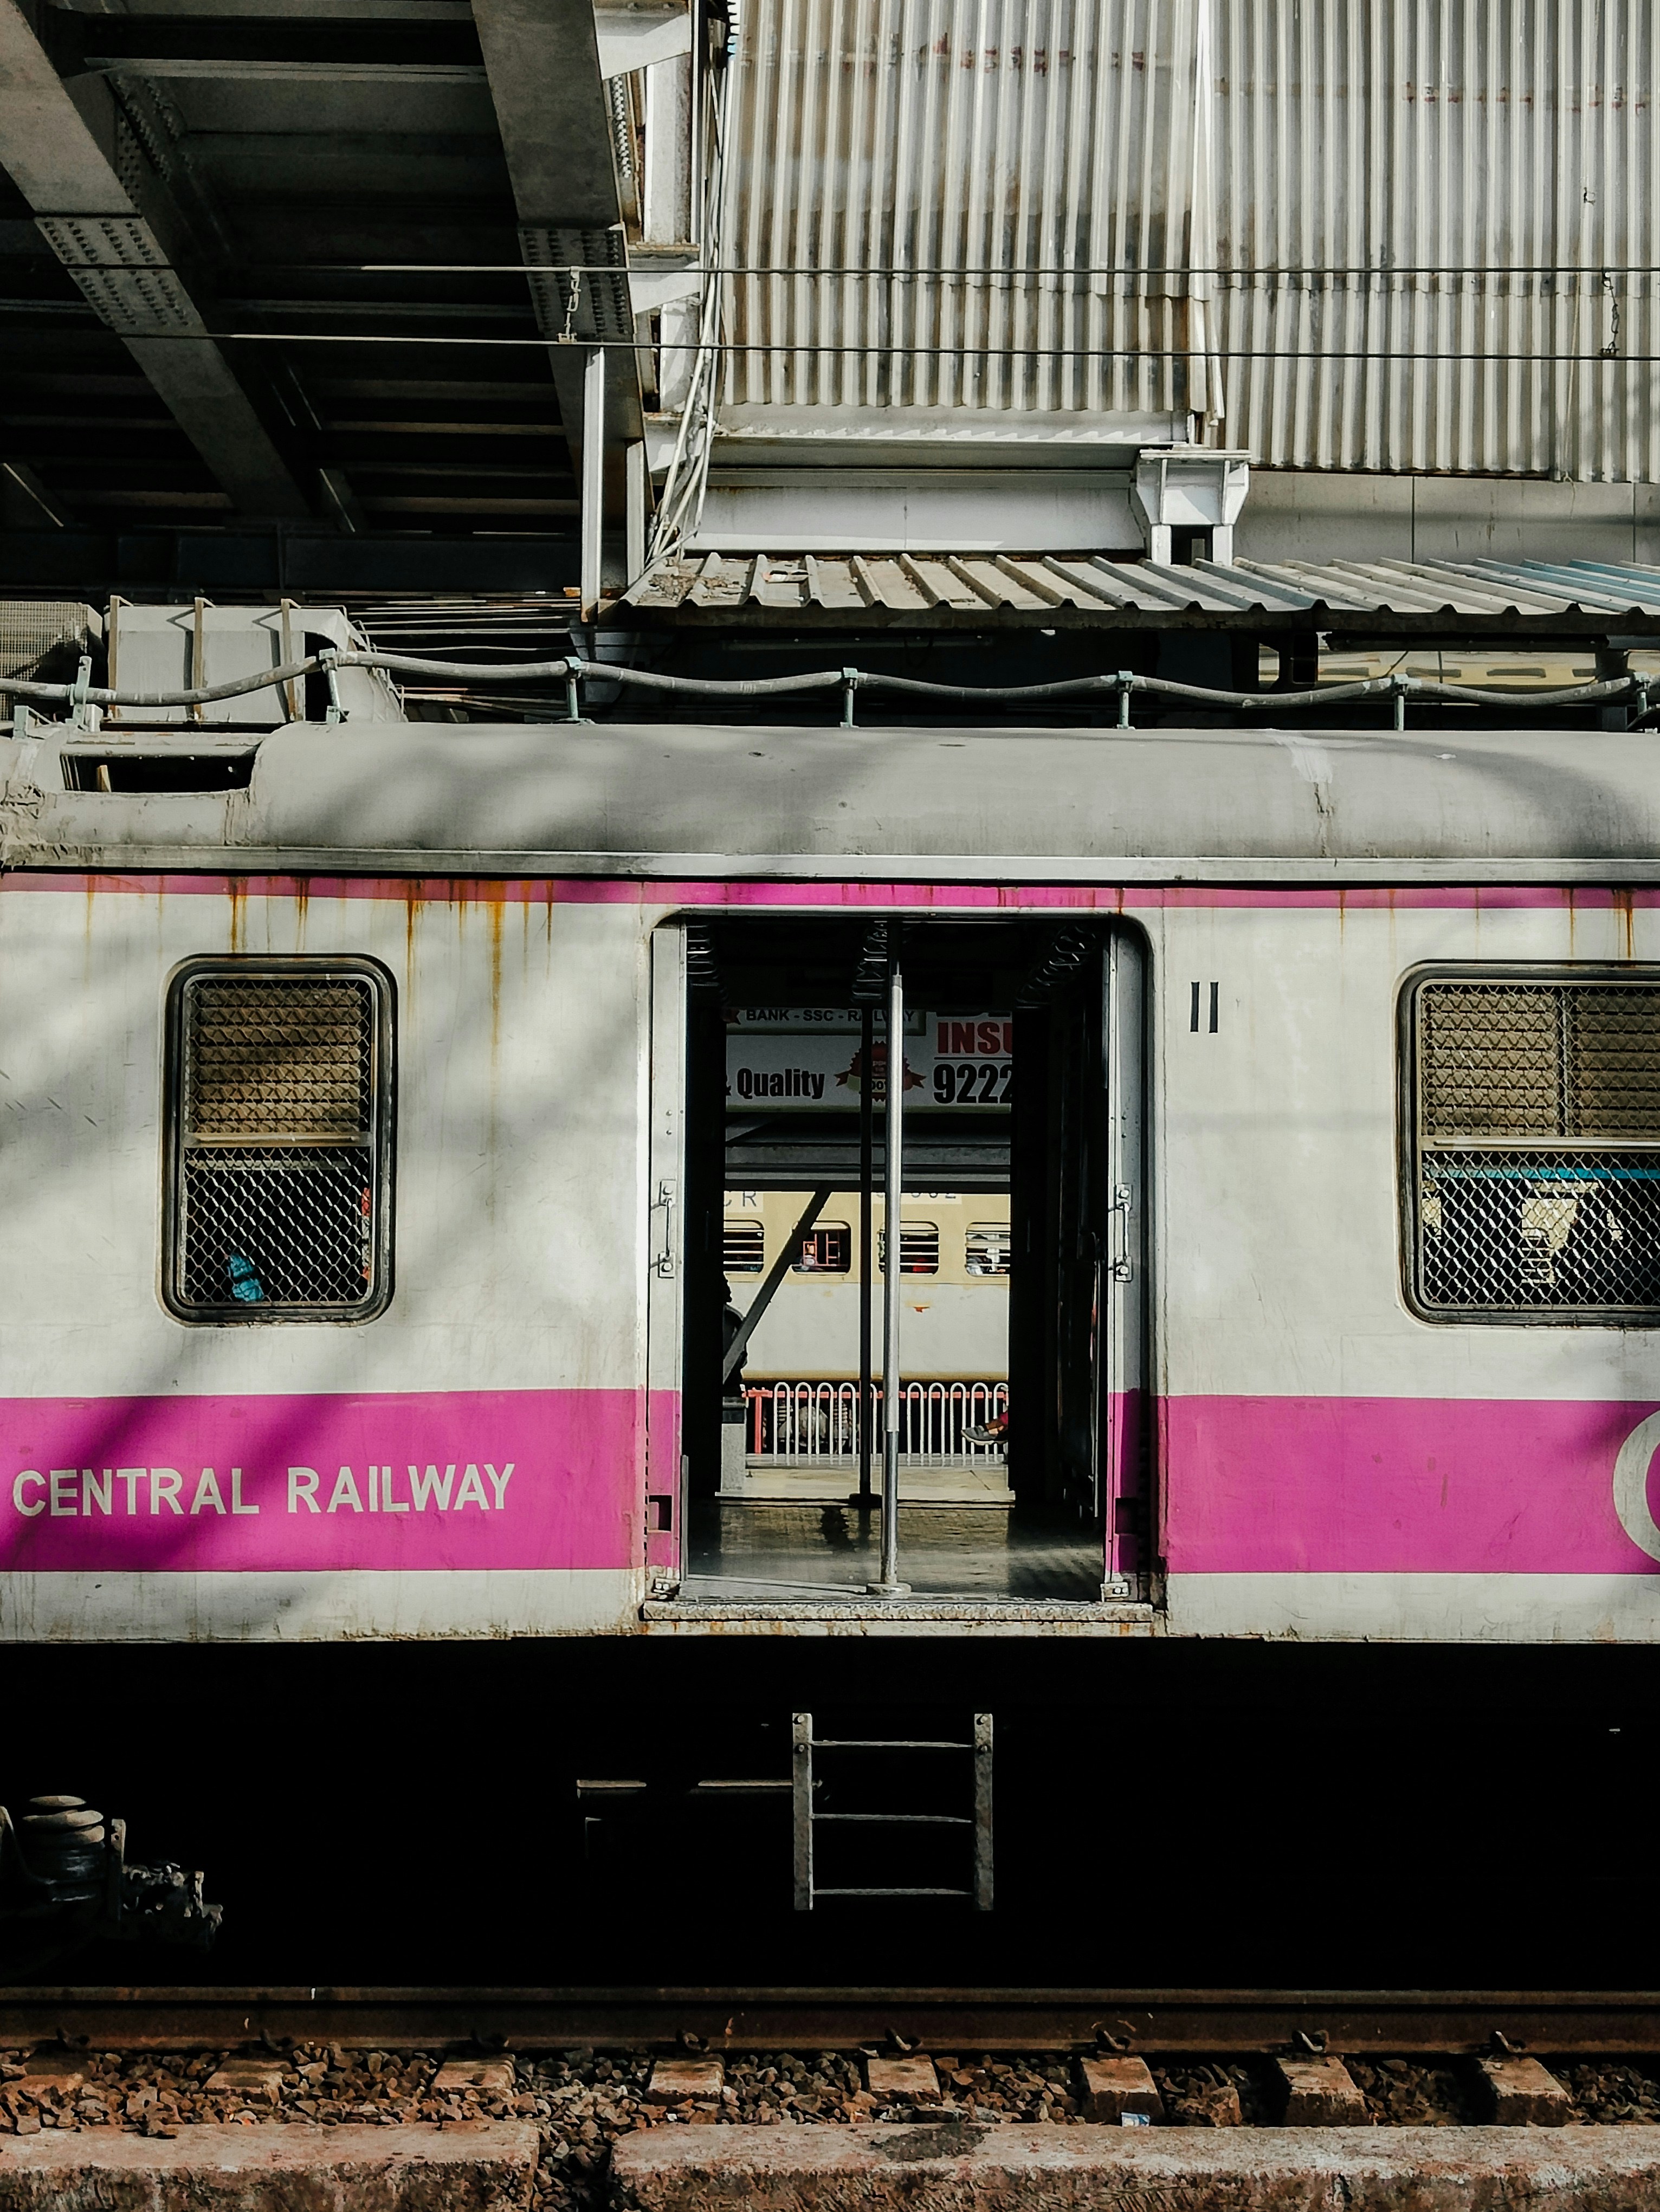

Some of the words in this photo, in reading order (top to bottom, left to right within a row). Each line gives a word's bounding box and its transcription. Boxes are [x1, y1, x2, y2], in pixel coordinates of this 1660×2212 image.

[746, 1010, 790, 1021] BANK
[803, 1010, 834, 1021] SSC
[738, 1068, 825, 1099] Quality
[12, 1467, 260, 1516] CENTRAL
[287, 1463, 515, 1513] RAILWAY
